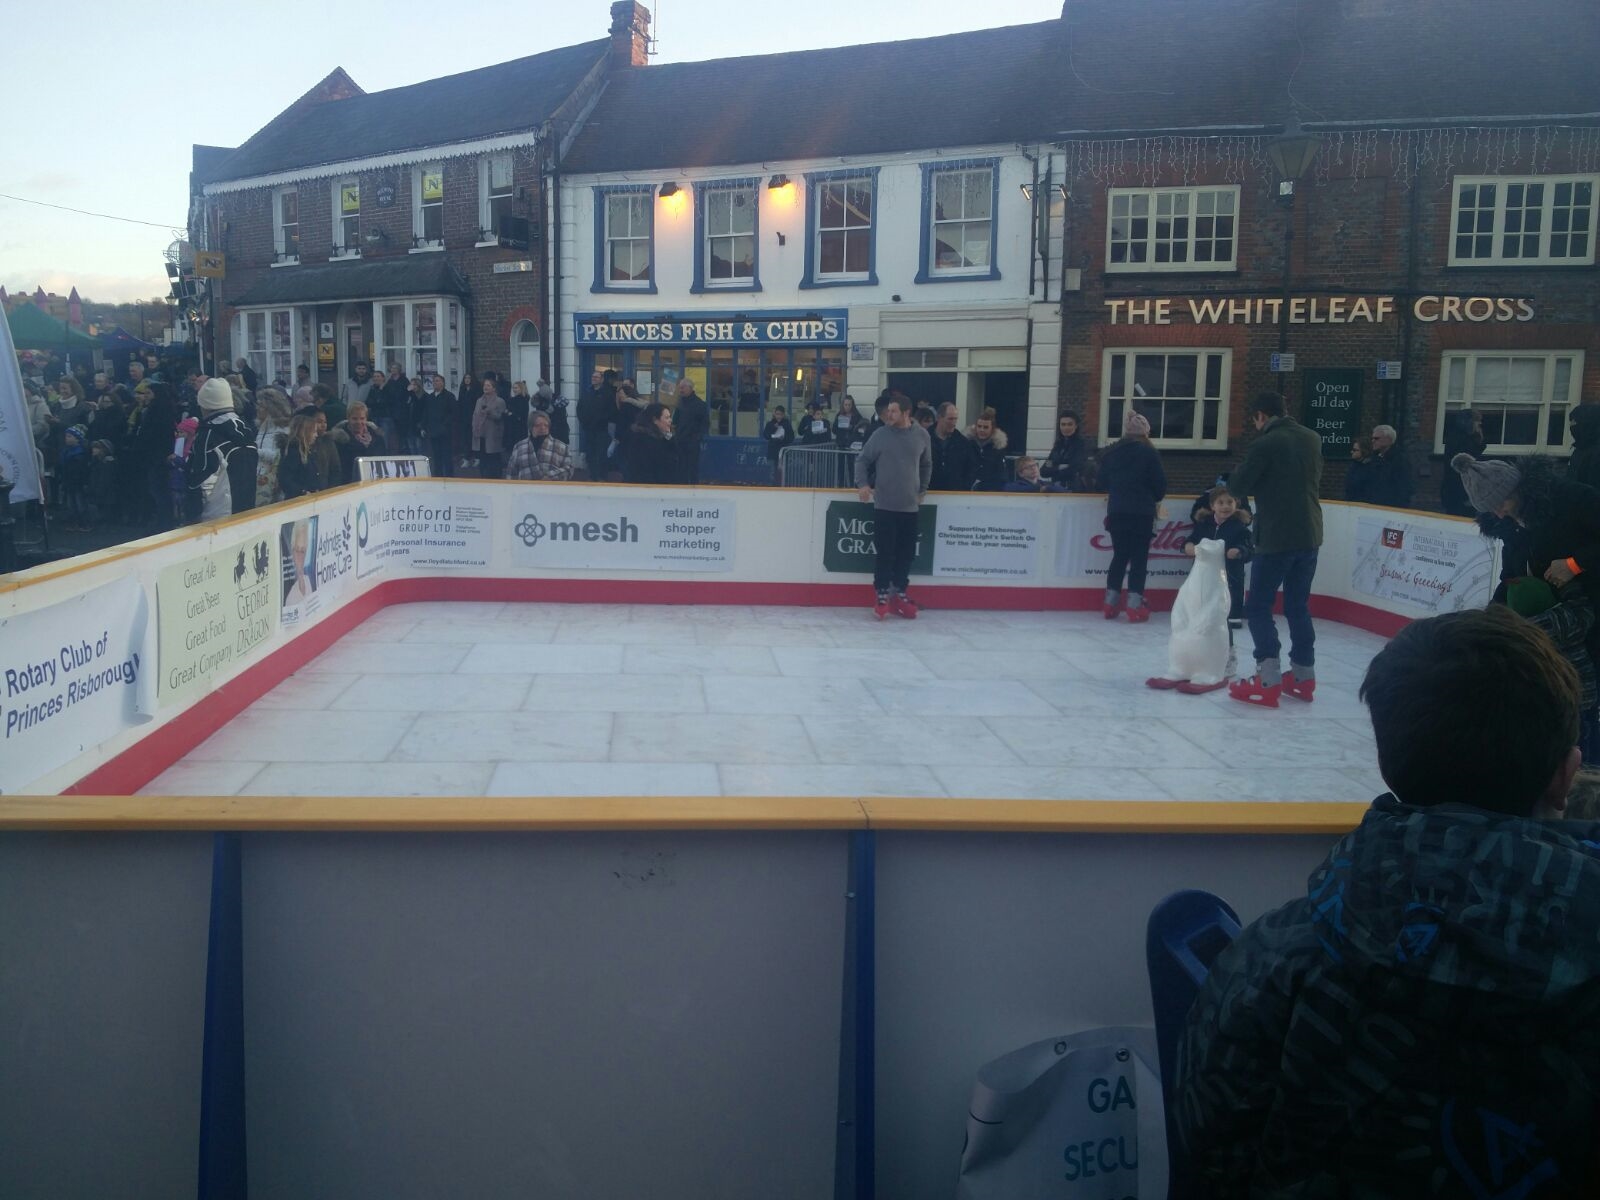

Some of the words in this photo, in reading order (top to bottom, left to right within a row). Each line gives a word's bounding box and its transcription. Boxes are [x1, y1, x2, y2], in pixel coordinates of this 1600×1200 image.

[1104, 299, 1170, 324] THE
[1189, 296, 1394, 324] WHITELEAF
[1414, 296, 1535, 321] CROSS
[582, 324, 674, 341] PRINCES
[681, 323, 734, 341] FISH
[742, 322, 758, 340] &
[767, 320, 839, 341] CHIPS
[1316, 381, 1350, 395] Open
[1311, 396, 1326, 407] all
[1330, 396, 1353, 410] day
[1316, 418, 1345, 429] Beer
[1321, 432, 1351, 443] rden
[382, 505, 452, 522] Latchford
[662, 508, 693, 519] retail
[697, 508, 720, 519] and
[400, 524, 430, 533] GROUP
[434, 524, 451, 533] LTD
[550, 516, 639, 542] mesh
[665, 523, 716, 535] shopper
[938, 532, 974, 540] Christmas
[948, 525, 986, 534] Supporting
[988, 526, 1027, 535] Risborough
[391, 538, 423, 547] Personal
[424, 538, 466, 547] Insurance
[659, 539, 721, 551] marketing
[184, 565, 204, 588] Great
[316, 560, 337, 588] Home
[338, 551, 352, 575] Care
[1379, 563, 1411, 583] Season's
[1413, 571, 1453, 596] Greetings
[187, 596, 206, 619] Great
[205, 591, 220, 610] Beer
[237, 584, 269, 620] GEORGE
[186, 622, 208, 650] Great
[210, 616, 226, 638] Food
[237, 618, 270, 653] DRAGON
[5, 659, 56, 698] Rotary
[60, 640, 93, 672] Club
[96, 630, 108, 658] of
[170, 660, 196, 689] Great
[199, 645, 232, 674] Company
[6, 694, 63, 739] Princes
